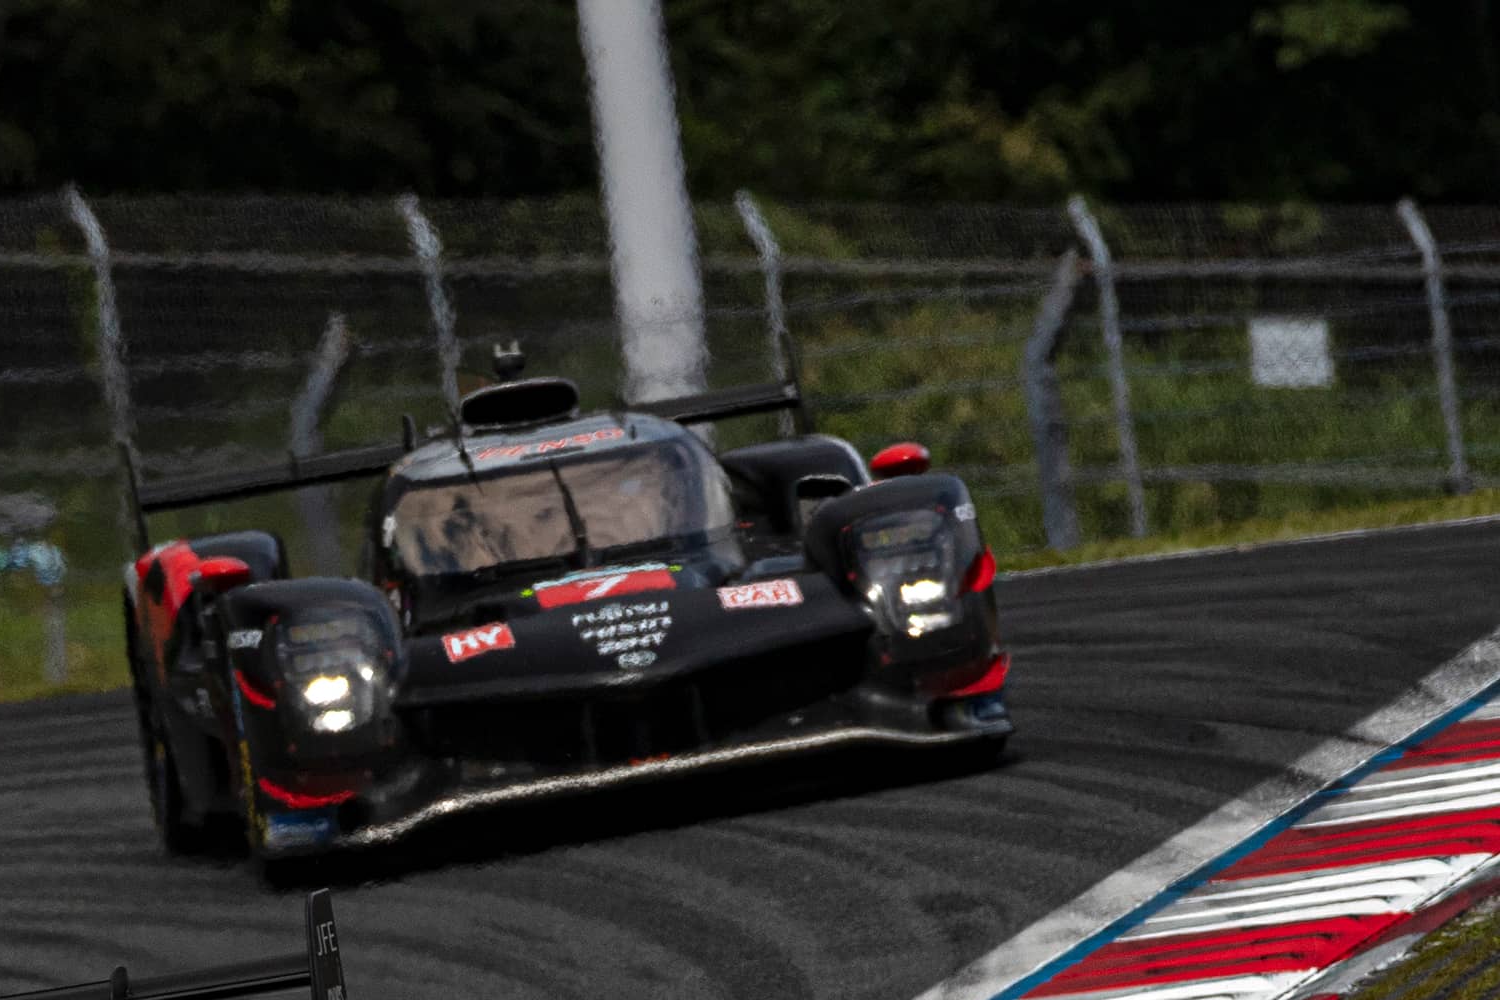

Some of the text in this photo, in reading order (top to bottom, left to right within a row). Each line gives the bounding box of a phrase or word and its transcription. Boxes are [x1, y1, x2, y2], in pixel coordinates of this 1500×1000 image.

[578, 573, 628, 601] 7
[451, 626, 502, 657] HY
[316, 921, 338, 956] JFE
